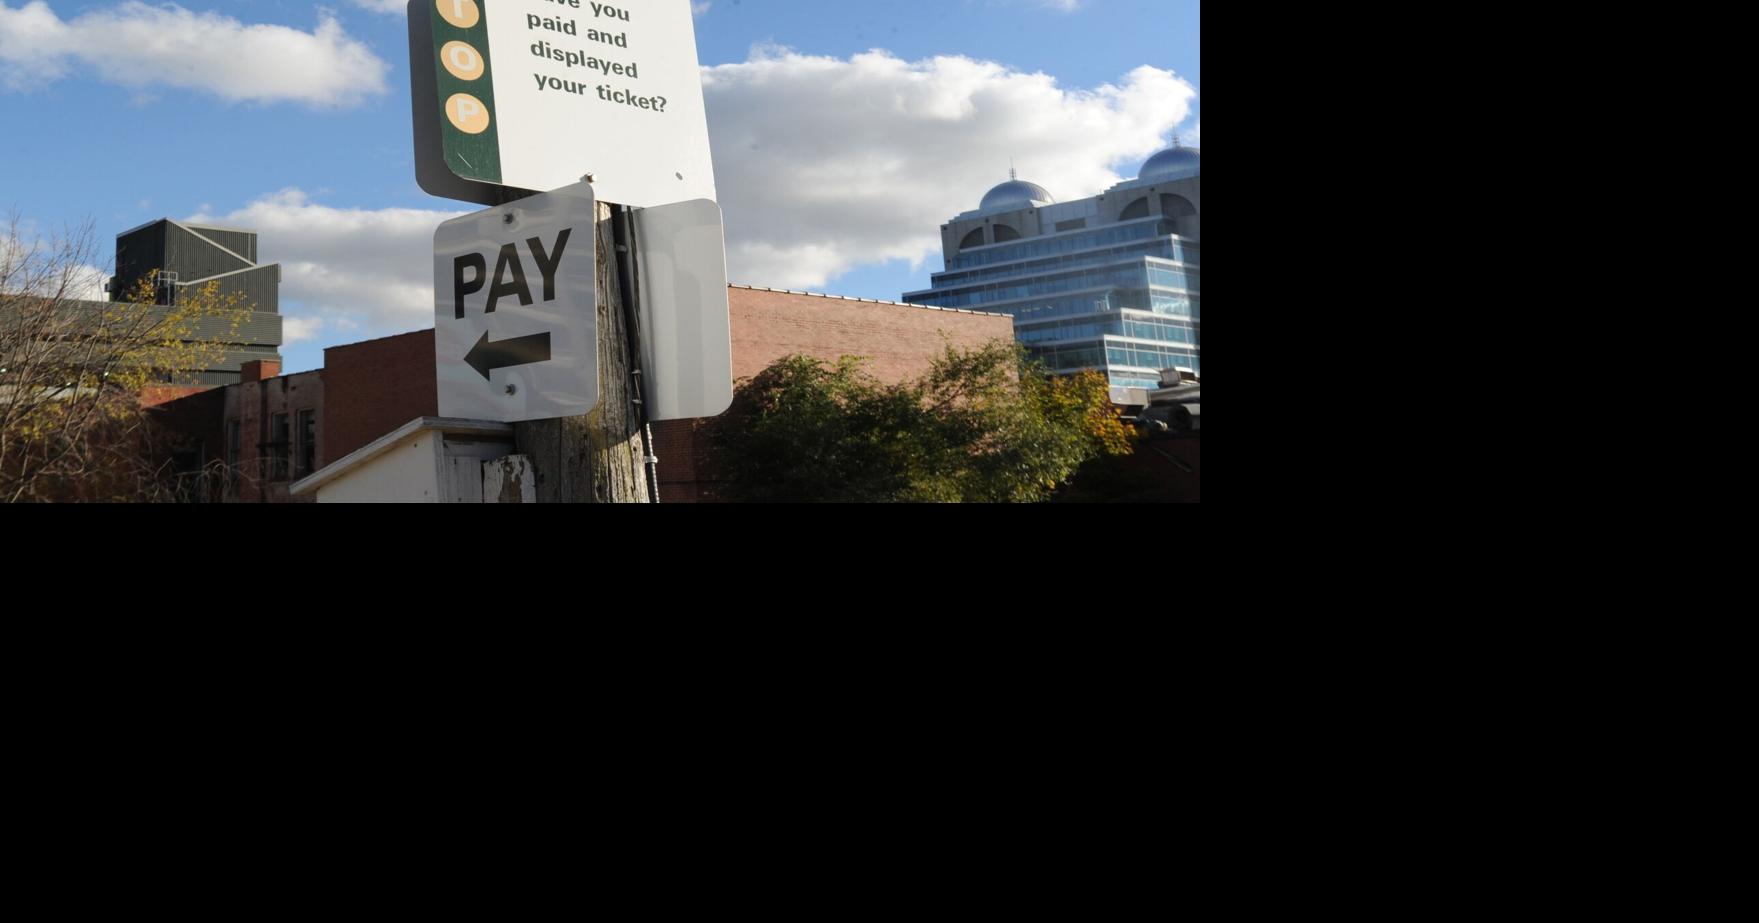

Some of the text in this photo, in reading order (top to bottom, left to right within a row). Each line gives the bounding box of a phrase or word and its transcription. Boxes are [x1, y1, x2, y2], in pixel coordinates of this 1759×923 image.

[526, 13, 628, 48] paid and
[590, 1, 630, 22] you
[530, 40, 639, 79] displayed
[534, 73, 667, 113] your ticket?
[453, 228, 573, 320] PAY
